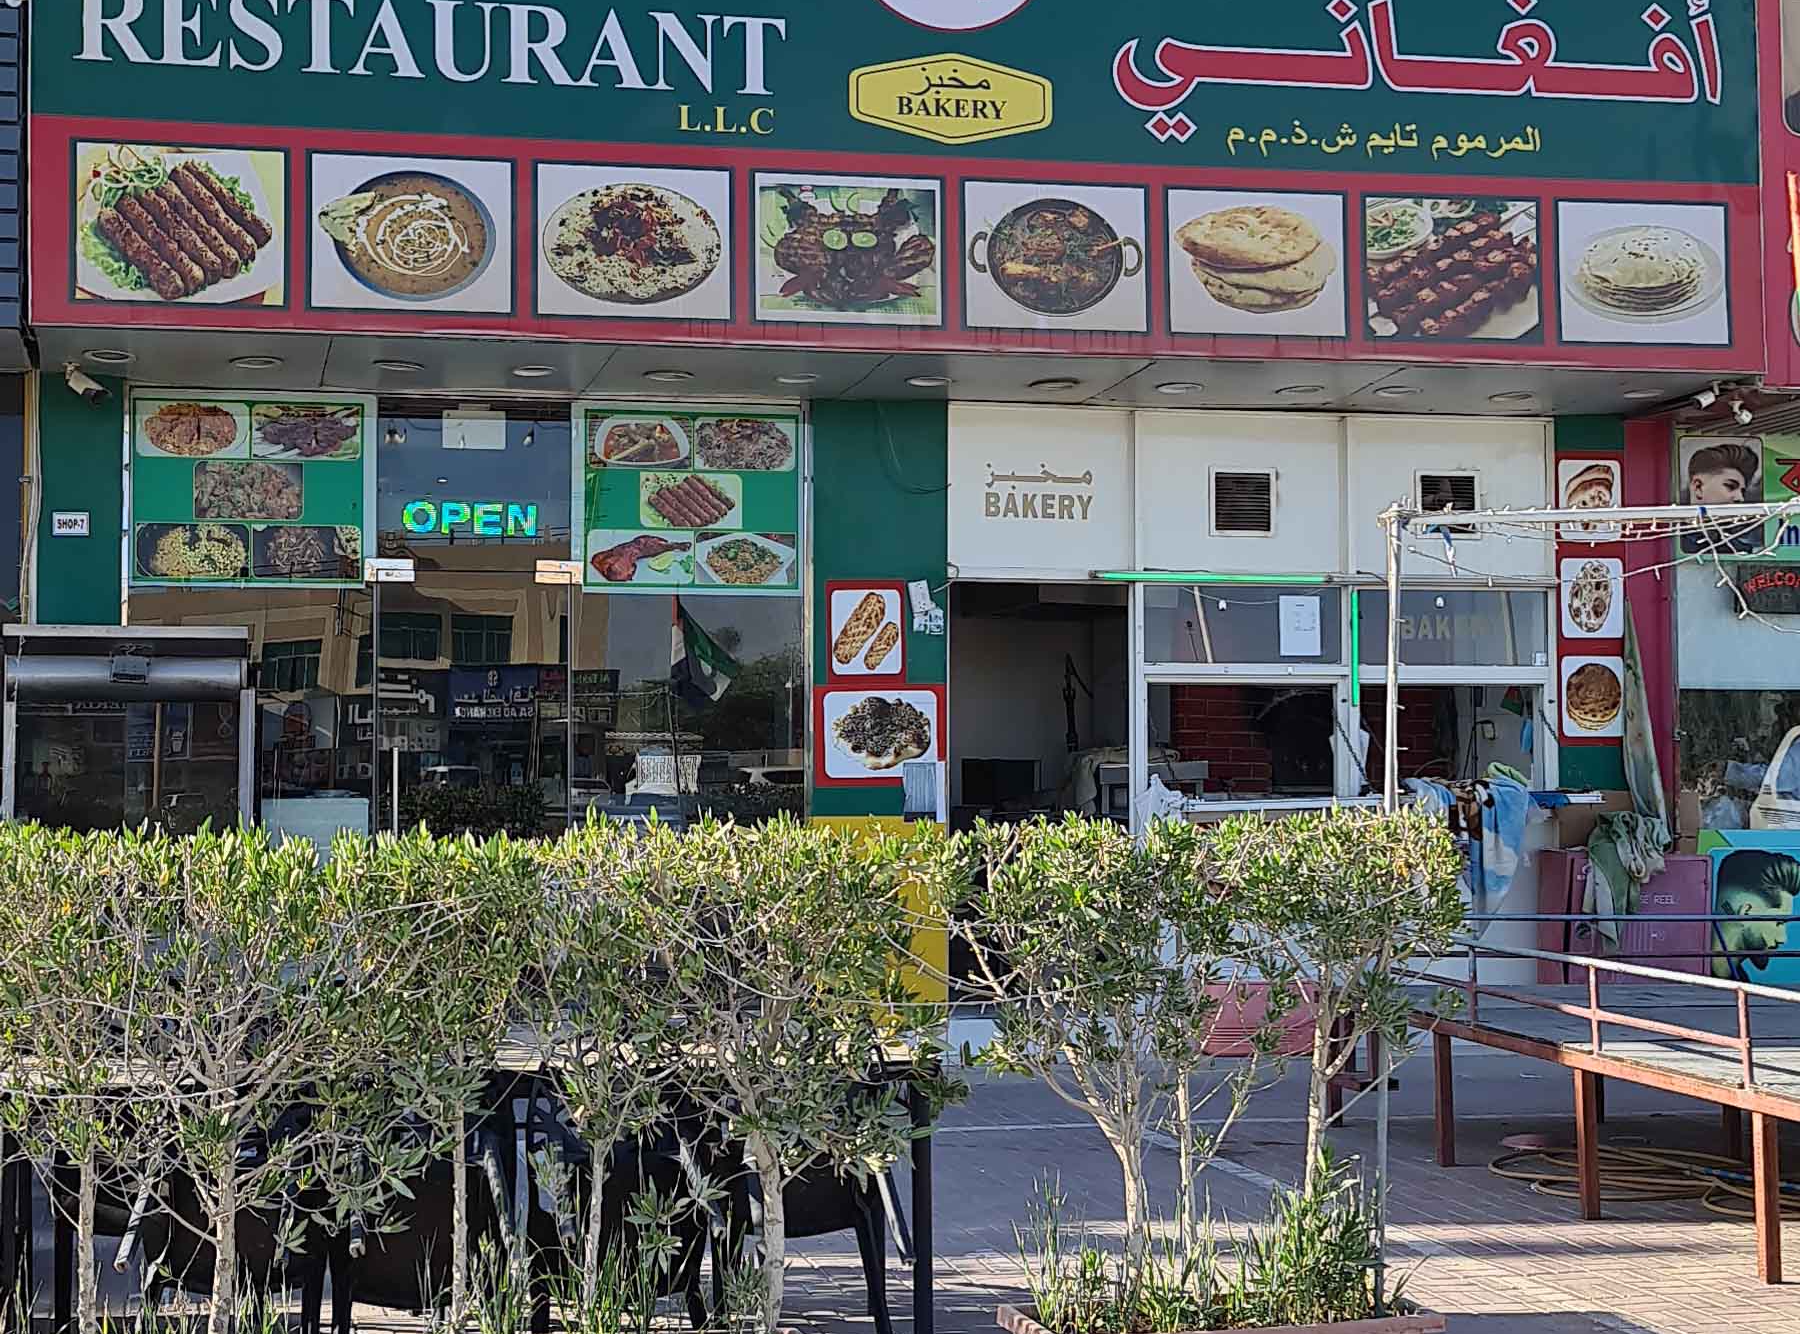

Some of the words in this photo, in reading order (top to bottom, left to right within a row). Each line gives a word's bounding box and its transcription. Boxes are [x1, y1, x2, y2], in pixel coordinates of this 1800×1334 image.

[906, 66, 992, 97] مخبز
[678, 105, 776, 135] L.L.C
[896, 95, 1007, 120] BAKERY
[1365, 122, 1419, 157] تايم
[1430, 125, 1542, 160] المرموم
[984, 462, 1093, 490] مخبز
[402, 500, 538, 537] OPEN
[984, 491, 1094, 520] BAKERY
[56, 518, 85, 530] SHOP-7
[1743, 570, 1800, 595] WELCO
[1401, 614, 1496, 641] BAK
